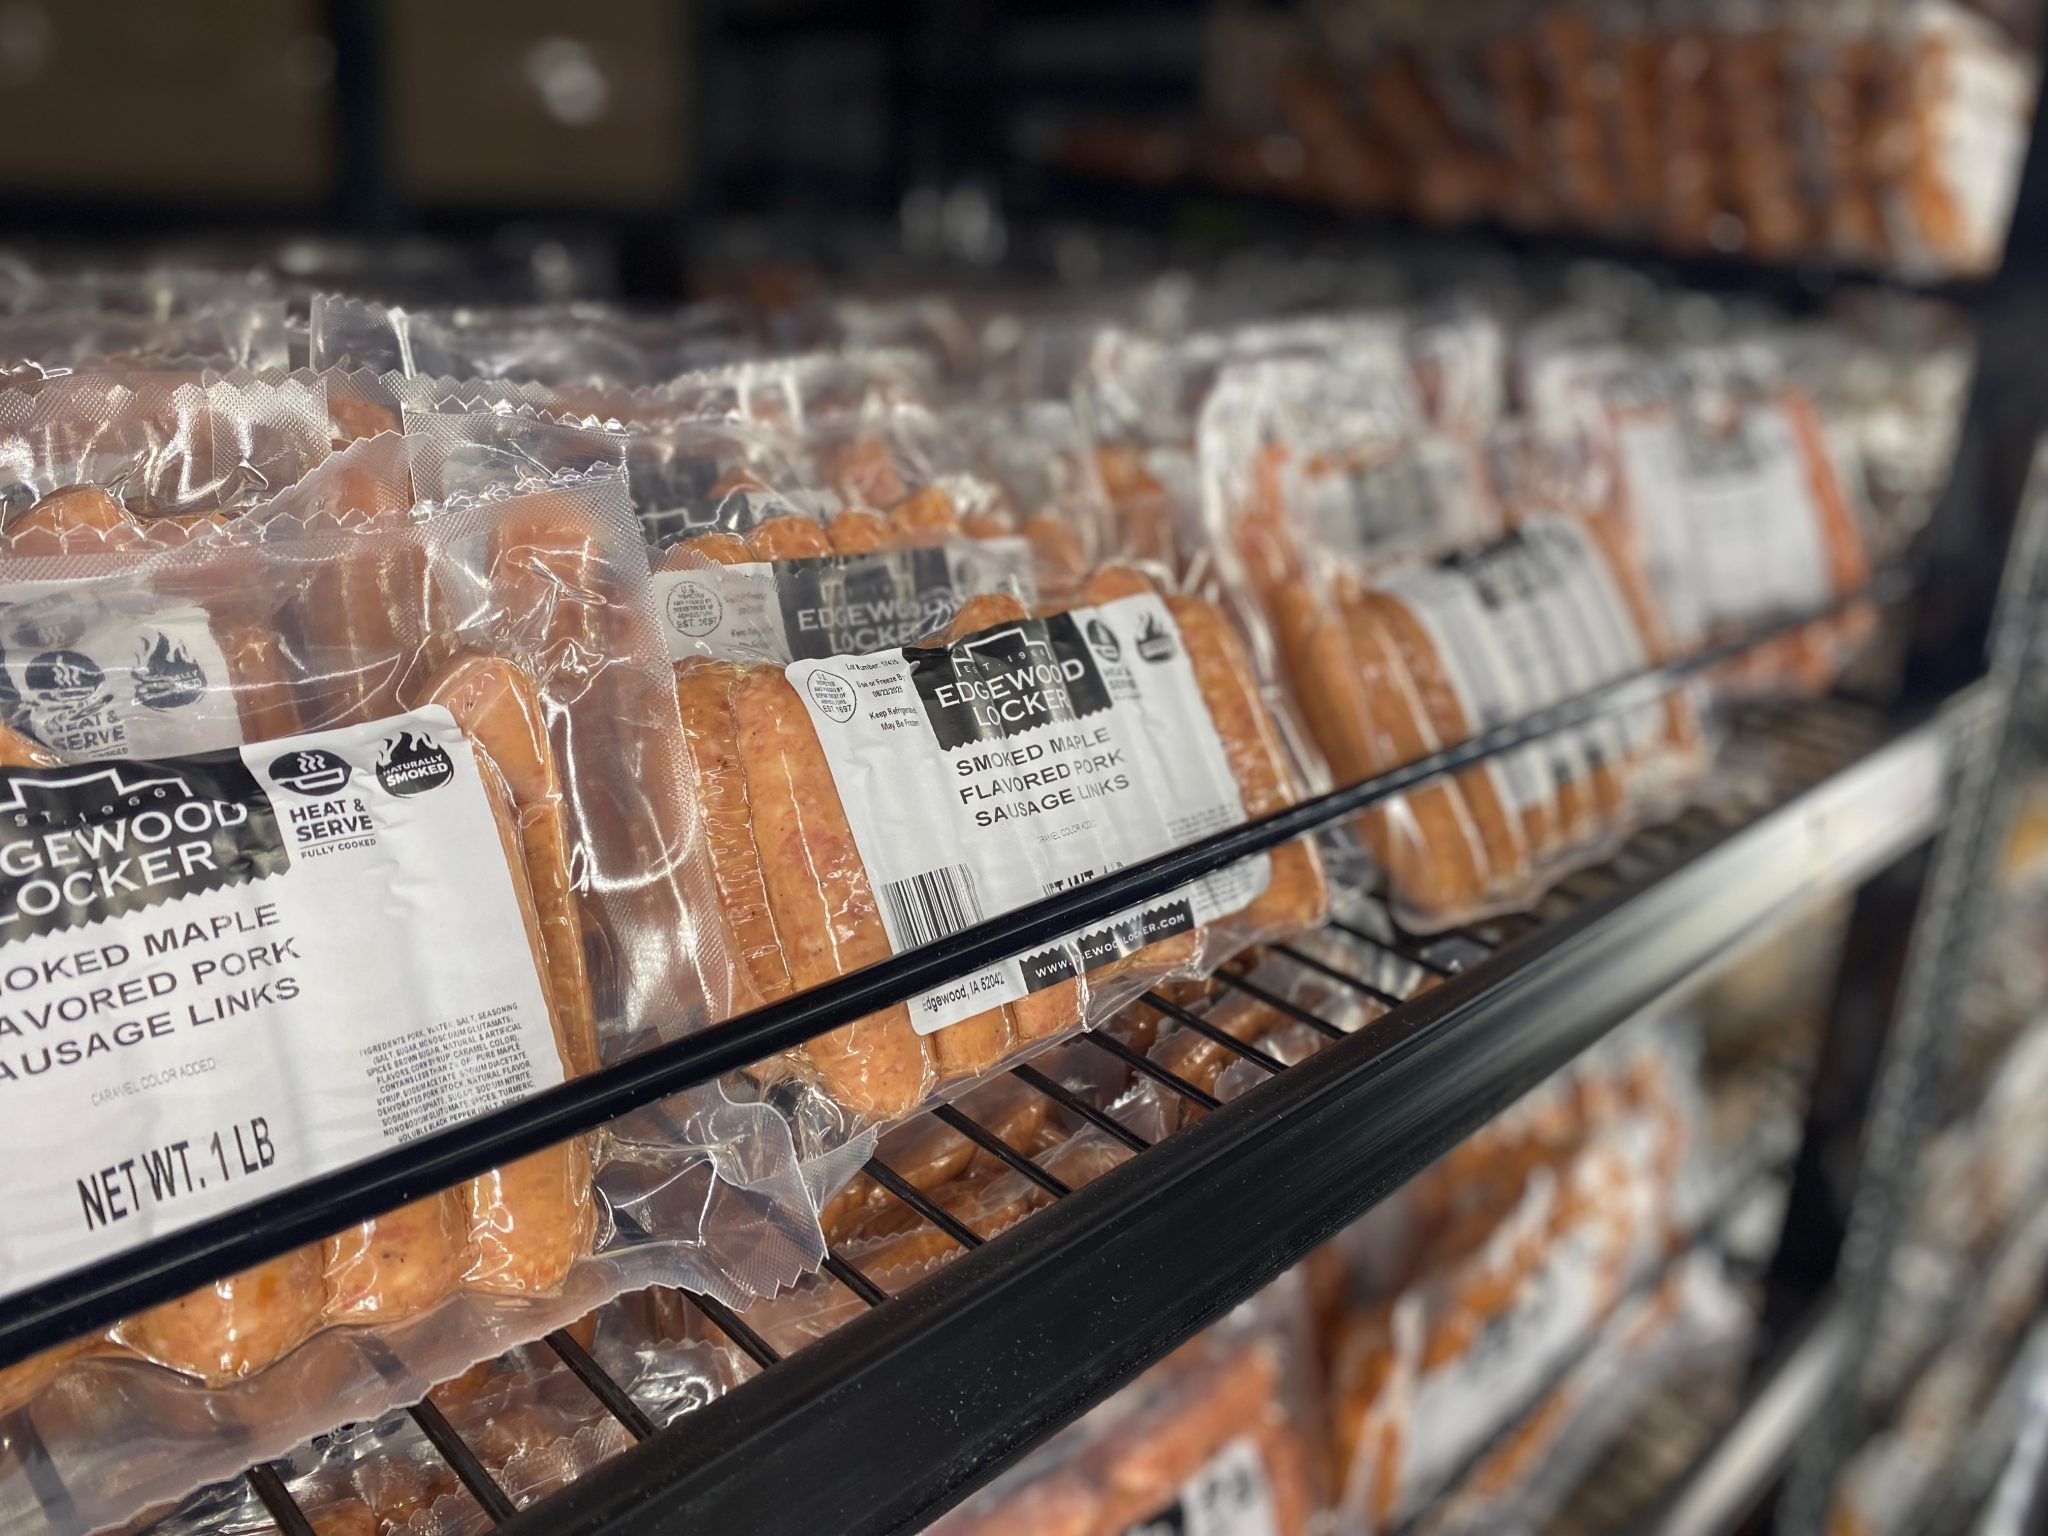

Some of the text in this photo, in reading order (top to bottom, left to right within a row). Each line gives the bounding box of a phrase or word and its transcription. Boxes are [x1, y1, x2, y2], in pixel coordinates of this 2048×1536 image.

[875, 676, 897, 686] Freeze
[934, 658, 1085, 708] EDGEWOOD
[869, 711, 888, 720] Keep
[972, 689, 1072, 727] LOCKER
[52, 724, 126, 751] SERVE
[880, 722, 896, 731] May
[895, 719, 905, 728] Be
[382, 753, 443, 777] NATURALLY
[956, 726, 1112, 777] SMOKED MAPLE
[386, 762, 449, 788] SMOKED
[959, 748, 1127, 805] FLAVORED PORK
[289, 797, 367, 823] HEAT &
[974, 773, 1131, 827] SAUSAGE LINKS
[296, 814, 374, 842] SERVE
[301, 838, 377, 860] FULLY COOKED
[0, 902, 282, 996] OKED MAPLE
[192, 936, 301, 986] PORK
[188, 976, 301, 1027] LINKS
[921, 971, 1006, 1012] Edgewood, IA 52042
[478, 1002, 519, 1021] SEASONING
[476, 1049, 496, 1062] PURE
[140, 1068, 178, 1090] COLOR
[76, 1116, 276, 1232] NET WT. 1 LB
